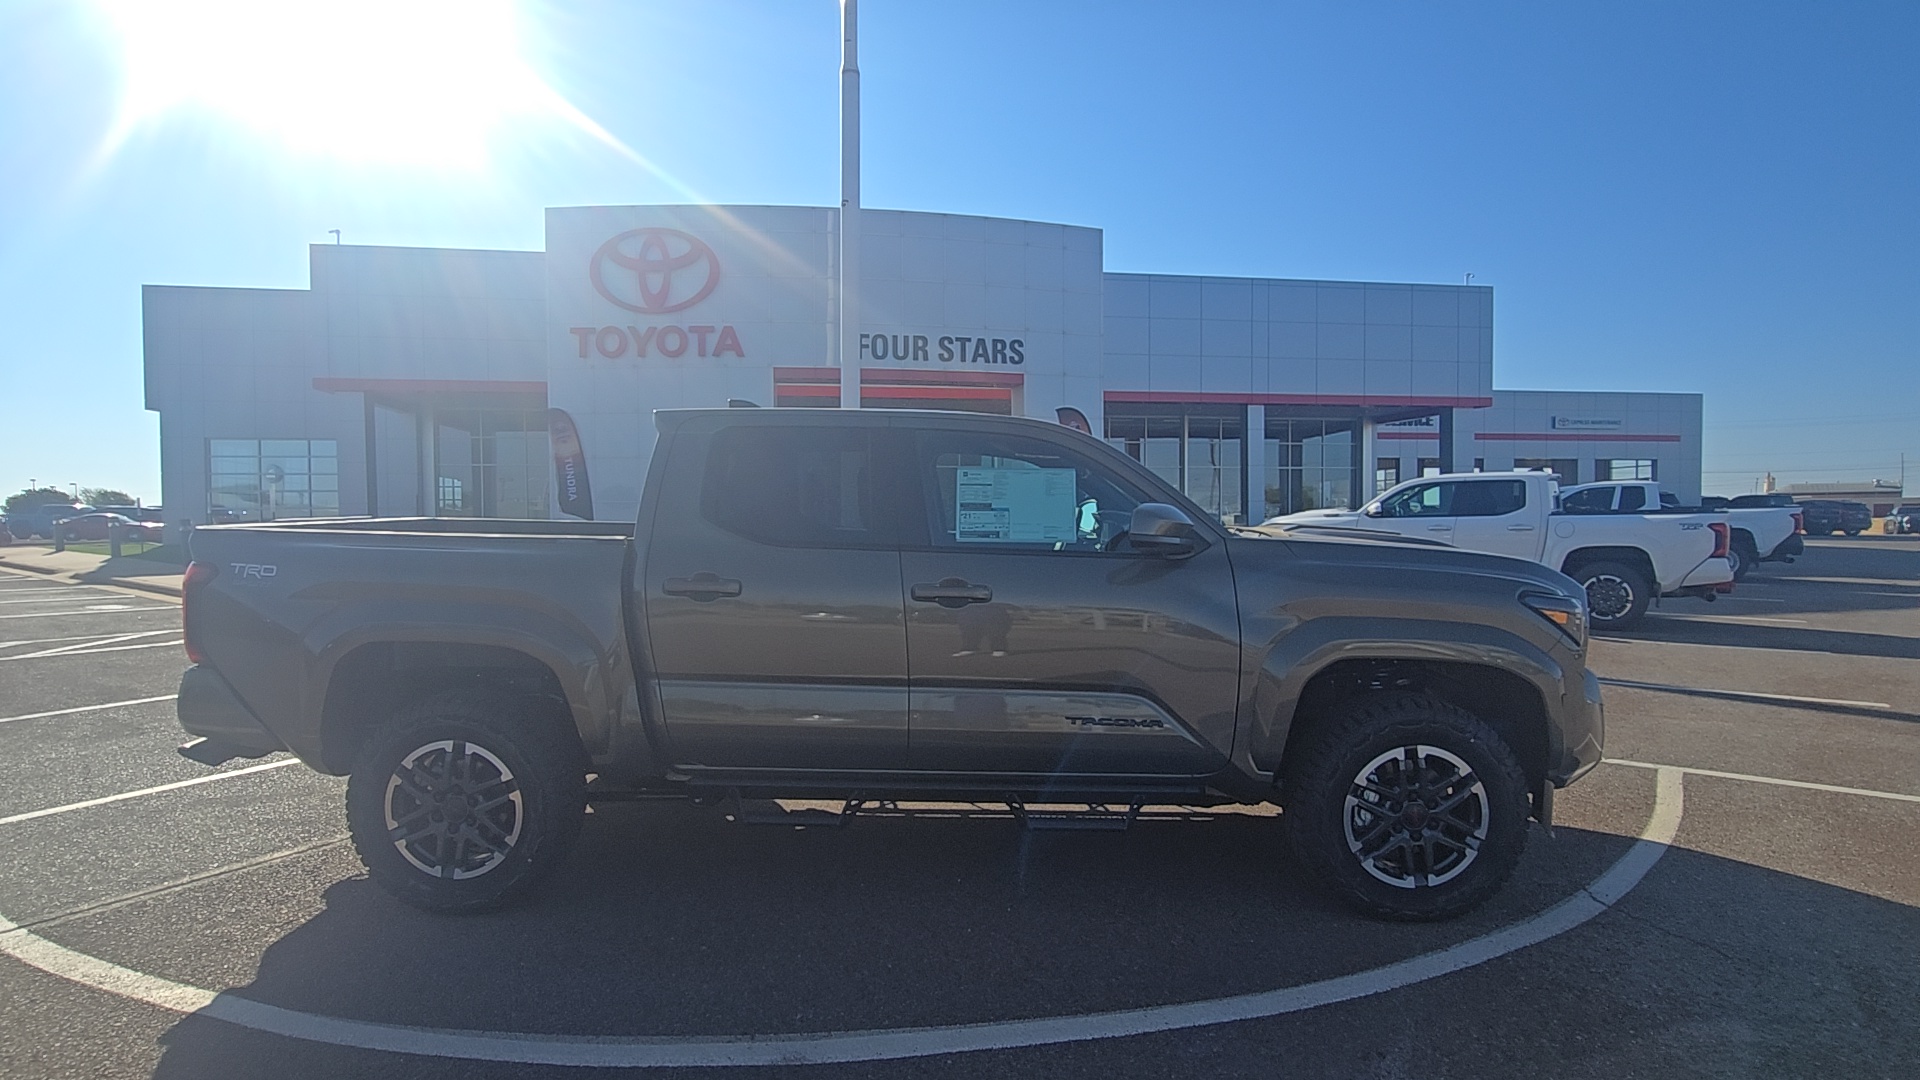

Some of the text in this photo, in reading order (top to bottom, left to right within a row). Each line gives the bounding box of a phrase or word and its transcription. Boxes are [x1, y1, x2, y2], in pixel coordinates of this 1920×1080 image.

[570, 325, 745, 358] TOYOTA
[859, 333, 1025, 365] FOUR STARS
[564, 458, 578, 501] TUNDRA
[230, 562, 277, 579] TRD
[1064, 716, 1164, 728] TACOMA
